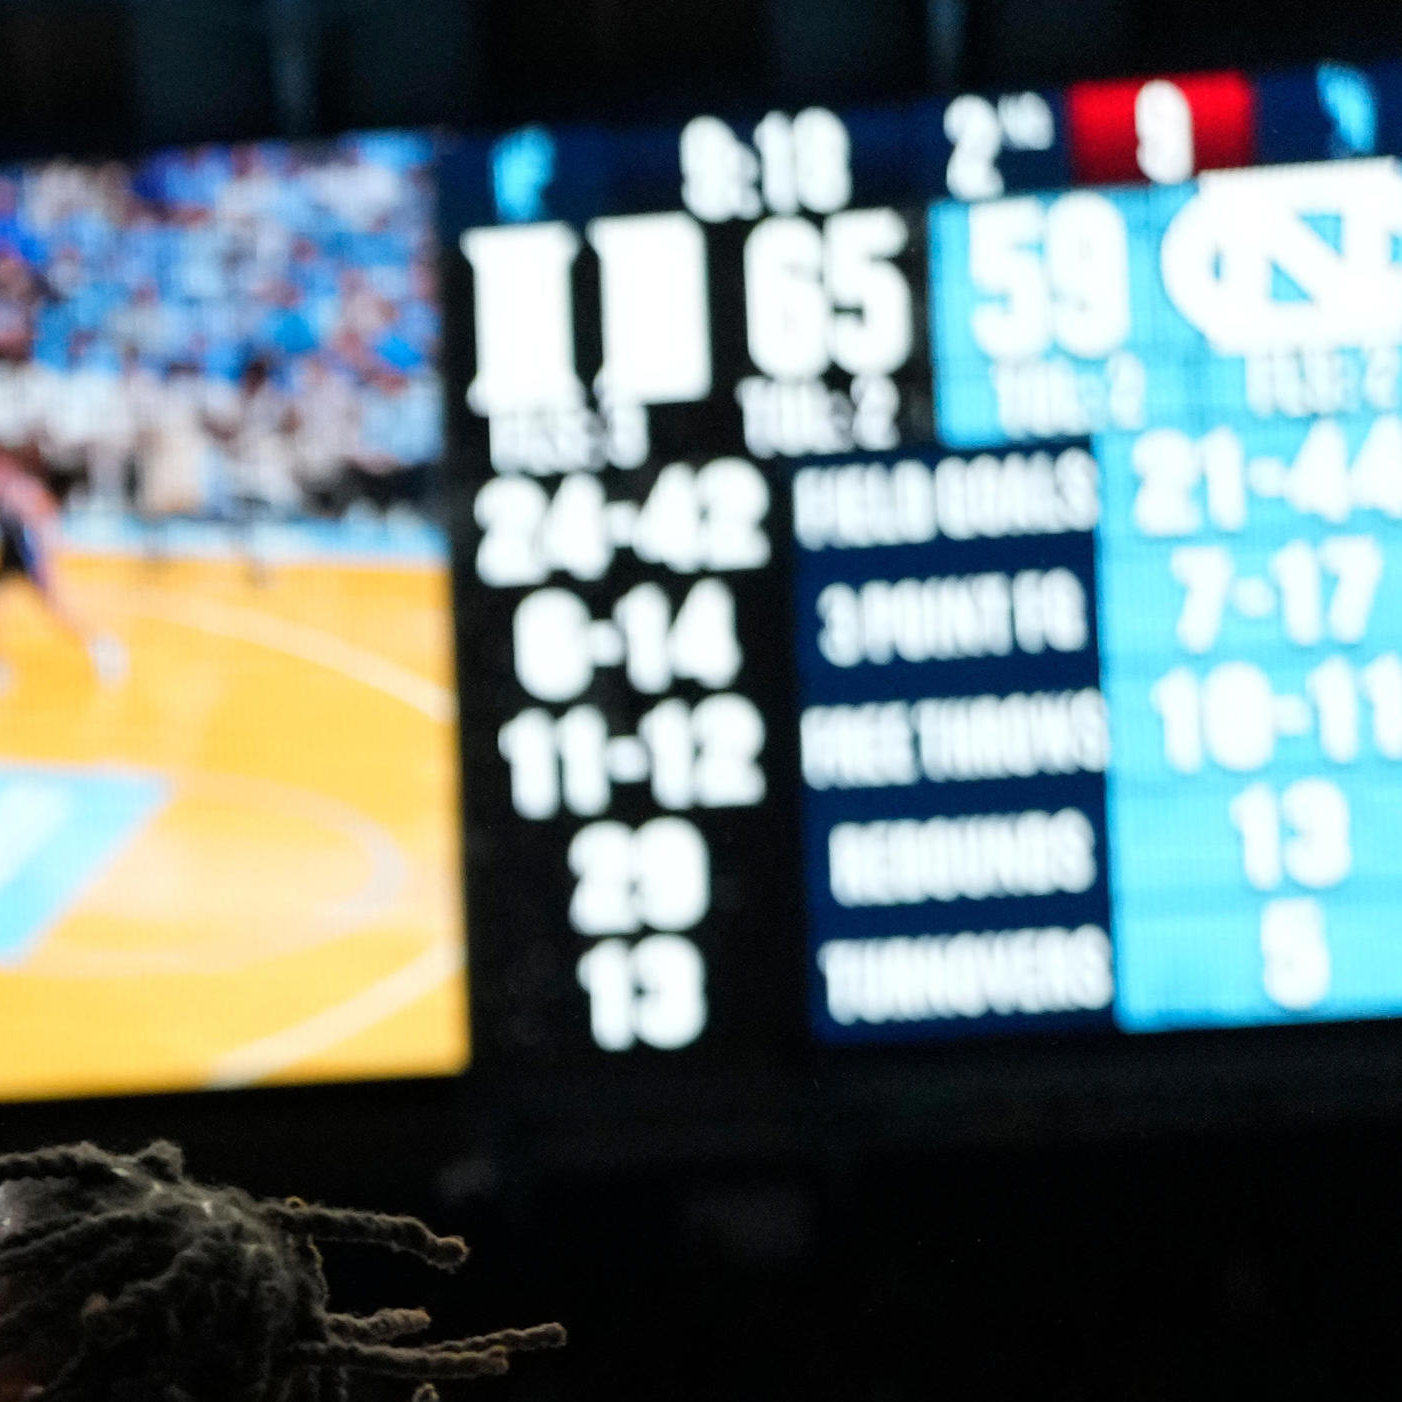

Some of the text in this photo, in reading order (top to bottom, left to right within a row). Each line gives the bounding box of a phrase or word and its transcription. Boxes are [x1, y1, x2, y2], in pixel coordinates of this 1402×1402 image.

[744, 207, 913, 379] 65
[968, 193, 1131, 361] 59
[474, 455, 771, 589] 24-42
[1133, 416, 1402, 536] 21-44
[1170, 534, 1382, 654] 7-17
[499, 692, 766, 820] 11-12
[1150, 654, 1402, 773] 10-11
[1230, 777, 1353, 891] 13
[578, 932, 708, 1051] 13
